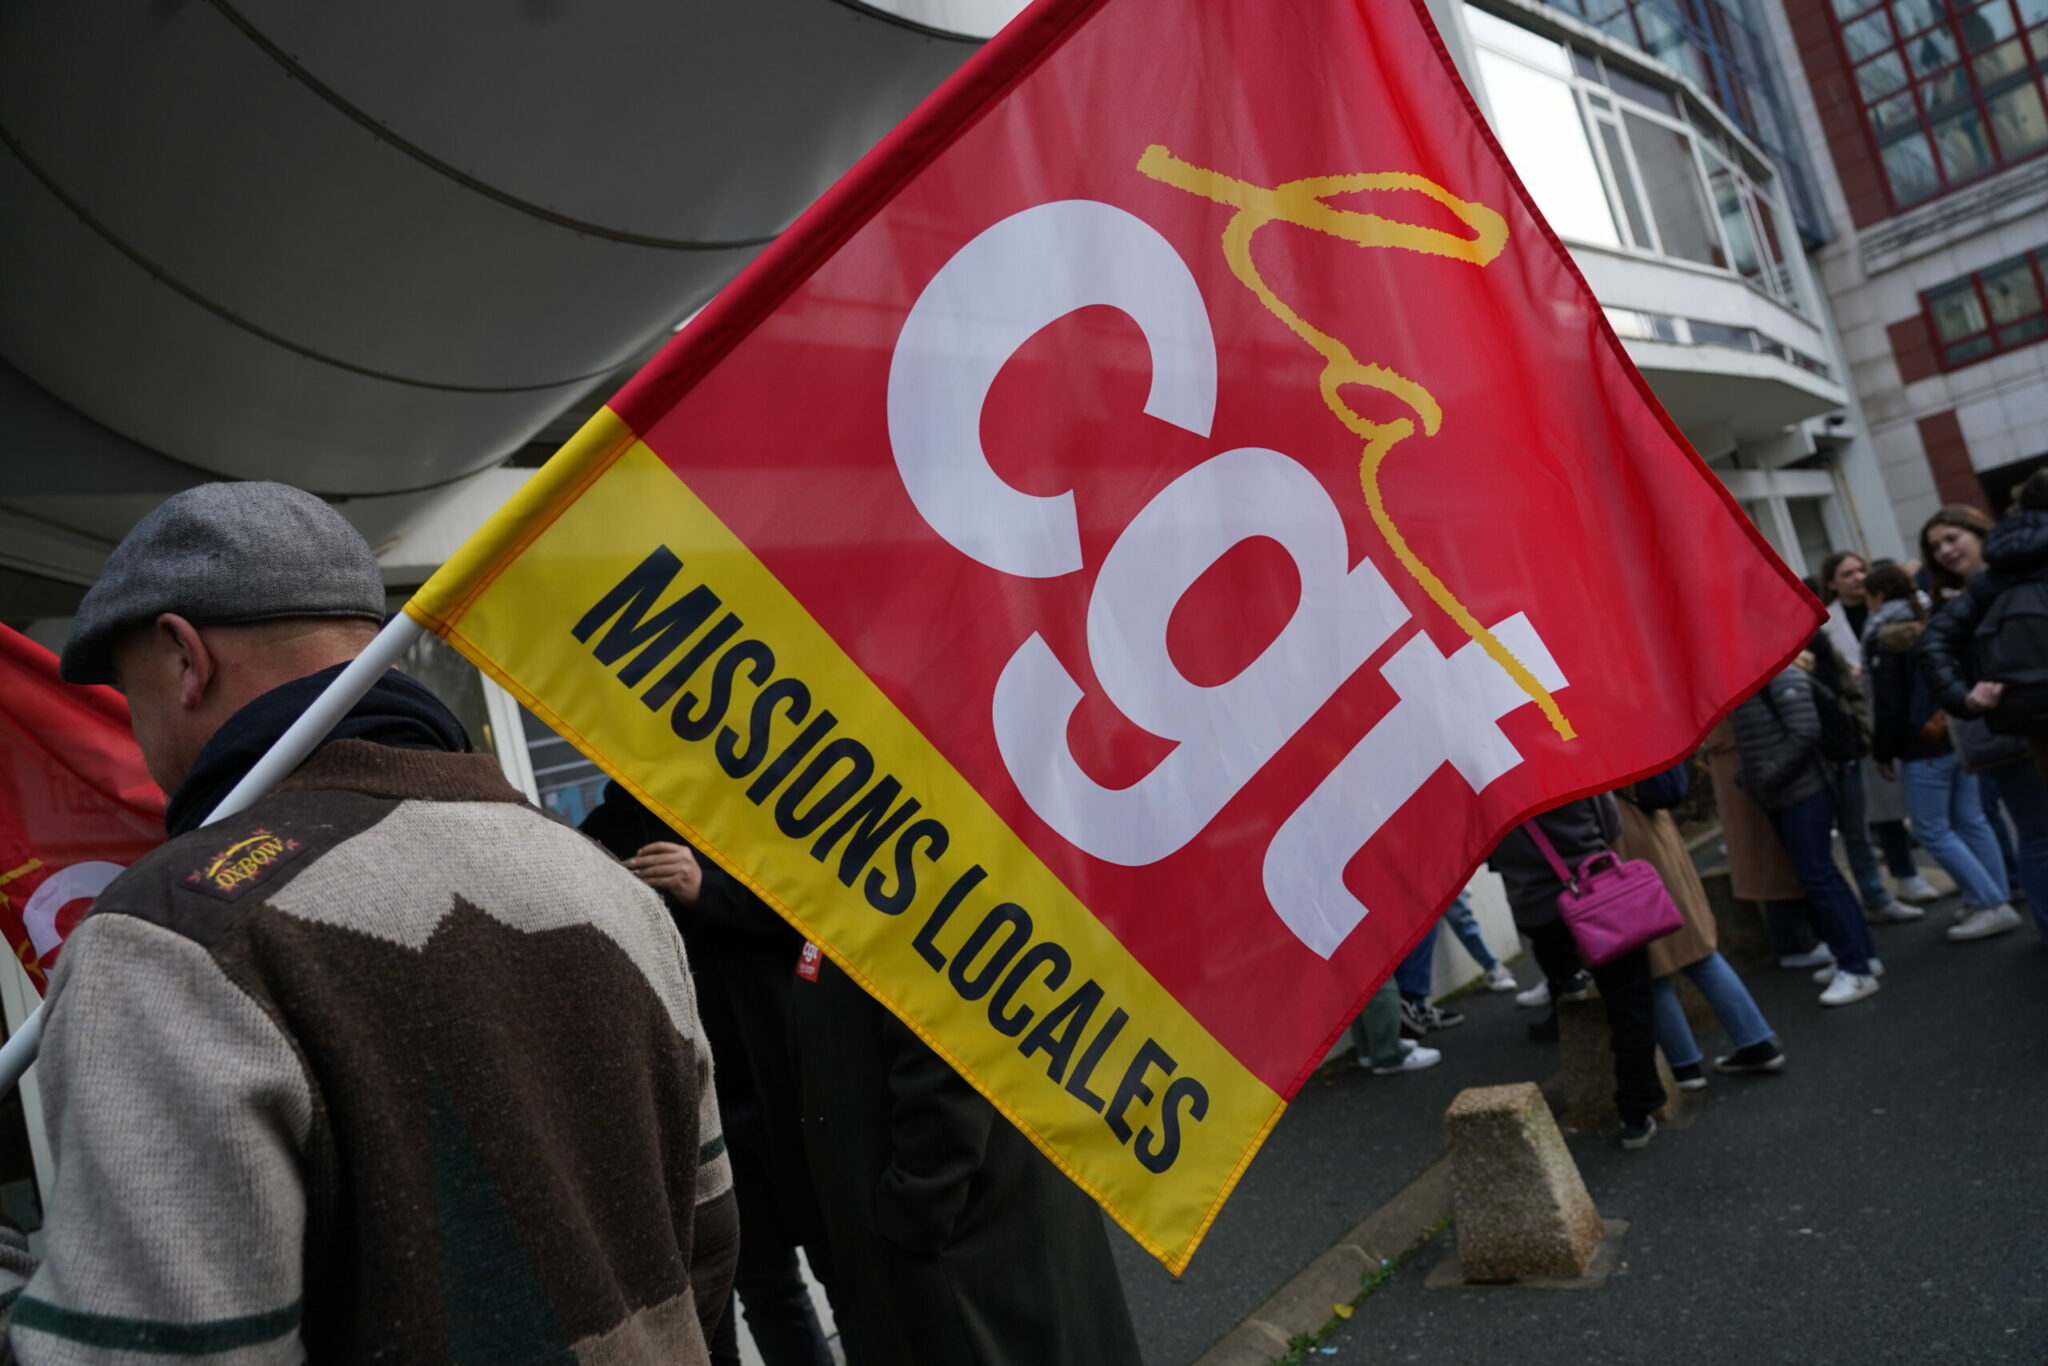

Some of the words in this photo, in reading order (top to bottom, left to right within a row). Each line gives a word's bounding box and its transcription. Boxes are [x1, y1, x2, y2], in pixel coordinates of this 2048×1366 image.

[215, 837, 284, 888] OXBOW
[571, 544, 949, 915] MISSIONS
[912, 864, 1209, 1174] LOCALES
[887, 199, 1569, 960] cgt
